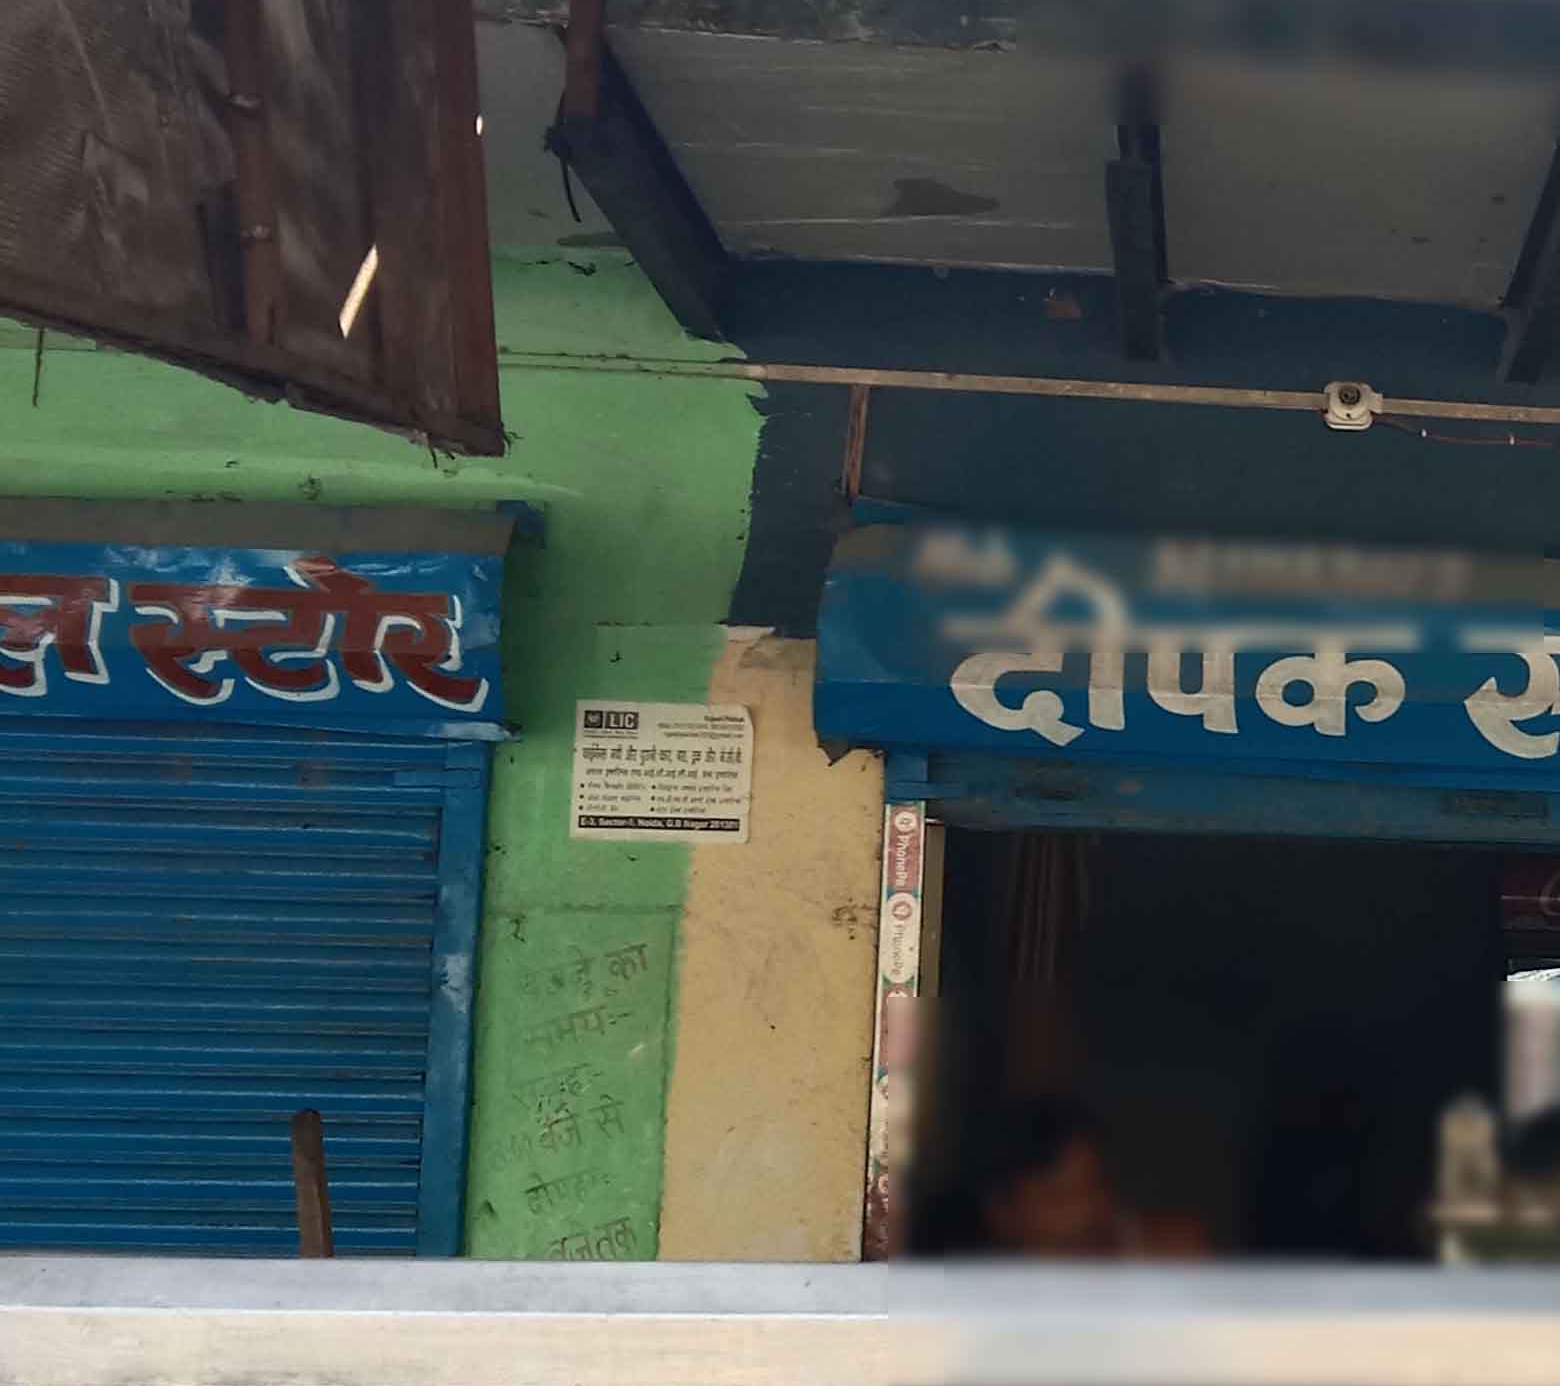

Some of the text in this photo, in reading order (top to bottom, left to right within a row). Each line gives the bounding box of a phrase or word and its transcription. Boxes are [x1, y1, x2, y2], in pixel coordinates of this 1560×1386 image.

[131, 556, 489, 711] स्टोर
[940, 555, 1422, 746] दीपक
[608, 713, 636, 729] LIC
